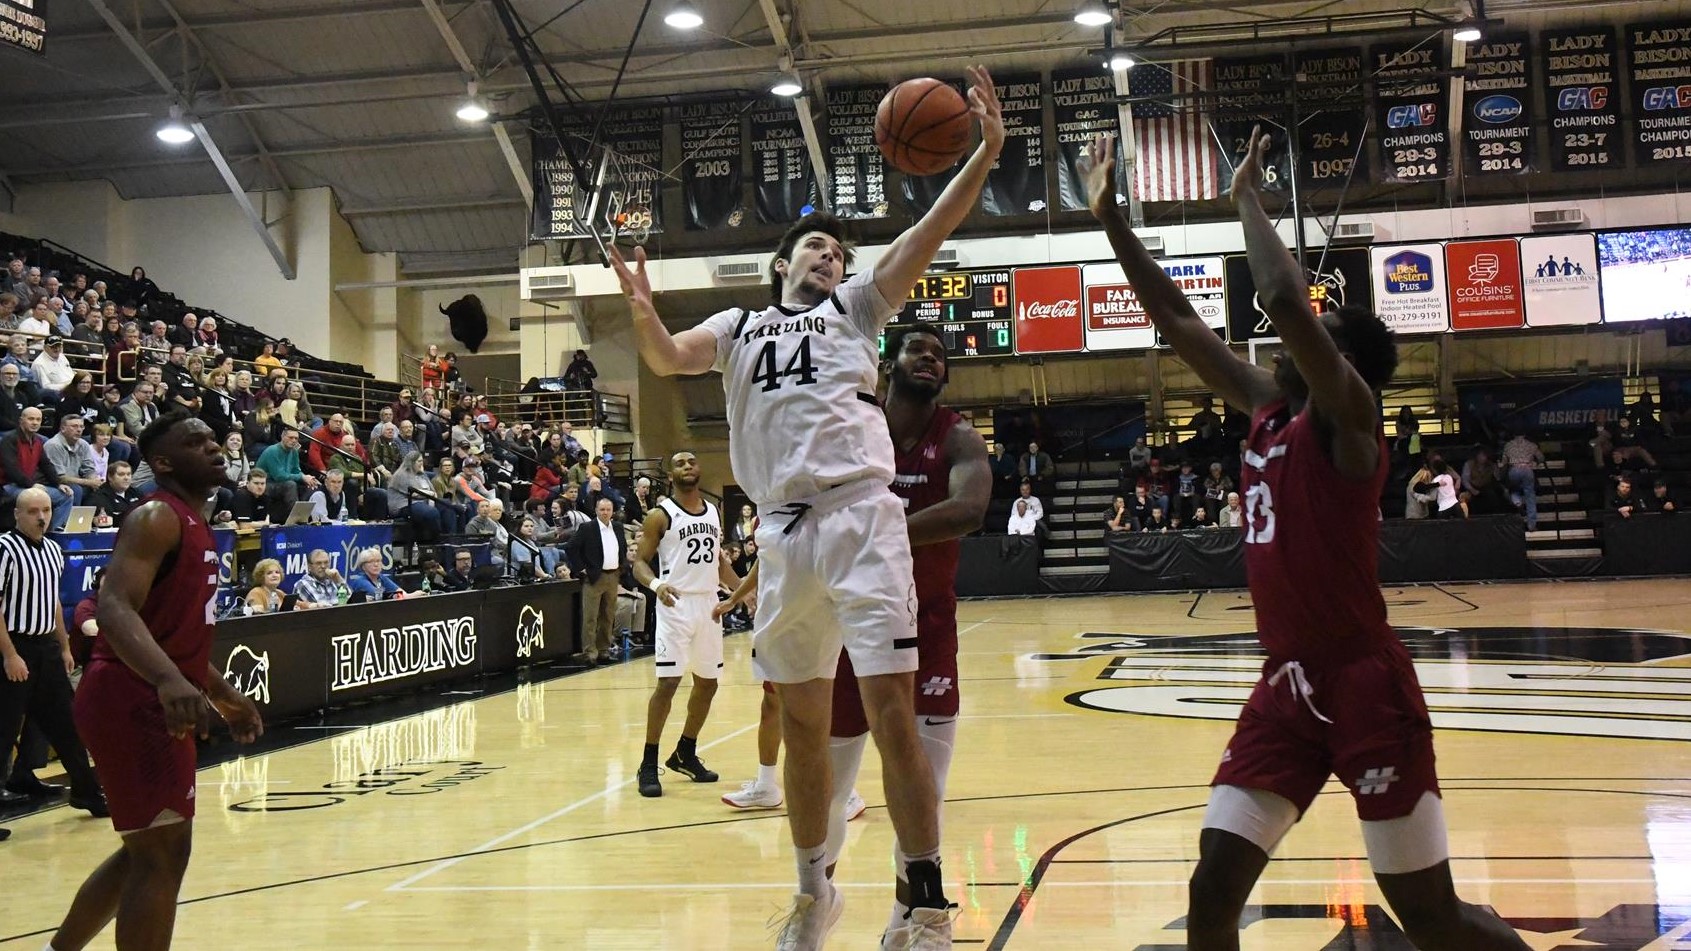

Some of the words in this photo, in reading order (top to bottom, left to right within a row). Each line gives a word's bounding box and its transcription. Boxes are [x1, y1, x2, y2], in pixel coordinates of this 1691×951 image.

[1549, 35, 1606, 51] LADY
[1634, 28, 1691, 45] LADY
[1466, 43, 1521, 59] LADY
[1378, 50, 1433, 67] LADY
[1549, 54, 1610, 70] BISON
[1301, 60, 1323, 74] ADY
[1053, 79, 1081, 93] LADY
[1084, 76, 1115, 89] BISON
[1549, 72, 1613, 86] BASKETBALL
[1009, 83, 1040, 97] BISON
[826, 91, 854, 105] LADY
[1054, 92, 1116, 107] VOLLEYBALL
[1557, 87, 1608, 110] GAC
[827, 104, 878, 116] VOLLEYBA
[1075, 110, 1099, 119] GAC
[1387, 103, 1437, 129] GAC
[1479, 107, 1521, 117] NCAA
[1057, 119, 1117, 132] TOURNAMENT
[1553, 115, 1616, 128] CHAMPIONS
[1640, 117, 1691, 129] TOURNAME
[1313, 131, 1349, 149] 26-4
[1469, 127, 1530, 140] TOURNAMENT
[1565, 133, 1607, 147] 23-7
[1640, 131, 1691, 143] CHAMPIO
[751, 138, 807, 151] TOURNAMEN
[843, 136, 873, 145] WEST
[1384, 133, 1444, 148] CHAMPIONS
[830, 144, 882, 155] CHAMPION
[1394, 147, 1437, 162] 29-3
[1479, 141, 1522, 156] 29-3
[1481, 158, 1522, 171] 2014
[1568, 152, 1608, 165] 2015
[695, 161, 731, 178] 2003
[1311, 157, 1354, 179] 1997
[1397, 163, 1438, 178] 2014
[552, 173, 573, 182] 1989
[551, 185, 573, 195] 1990
[552, 198, 573, 208] 1991
[551, 210, 573, 220] 1993
[551, 223, 574, 233] 1994
[1396, 263, 1418, 274] Best
[972, 273, 1009, 284] VISITOR
[1172, 277, 1223, 290] ARTIN
[1388, 271, 1428, 283] Western
[1525, 277, 1541, 285] FIRST
[994, 286, 1008, 307] 0
[1107, 290, 1136, 301] FAR
[1456, 285, 1514, 297] COUSINS'
[916, 309, 940, 317] PERIOD
[971, 310, 995, 319] BONUS
[1027, 300, 1080, 319] Coca-Cola
[1103, 315, 1146, 325] INSURANCE
[1382, 312, 1442, 322] 501-279-9191
[943, 324, 965, 332] FOULS
[987, 321, 1009, 330] FOULS
[997, 329, 1009, 347] 0
[752, 335, 818, 393] 44
[1538, 408, 1618, 425] BASKETBLL
[1245, 480, 1276, 544] 13
[678, 522, 718, 540] HARDING
[687, 537, 715, 564] 23
[286, 554, 309, 575] MA
[331, 616, 477, 691] HARDING
